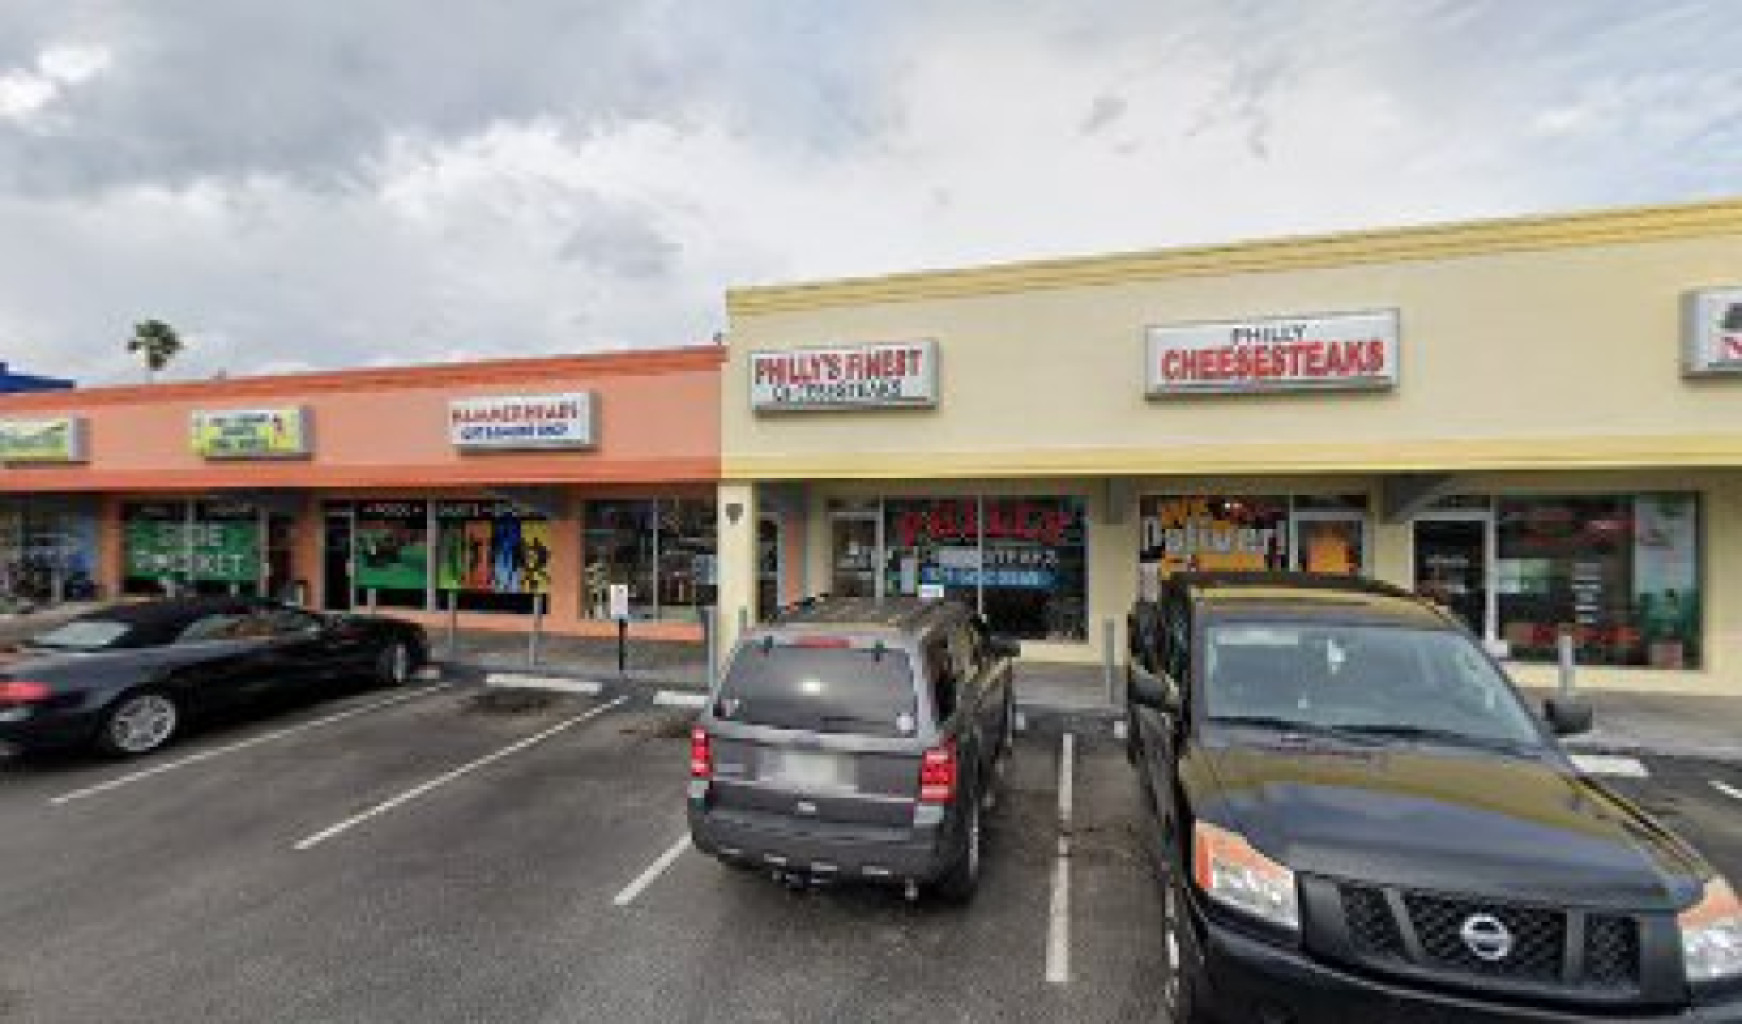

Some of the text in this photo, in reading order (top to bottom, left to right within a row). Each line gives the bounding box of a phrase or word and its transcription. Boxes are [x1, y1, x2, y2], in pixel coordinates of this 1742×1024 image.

[1230, 319, 1308, 344] PHILLY
[754, 349, 922, 386] PHILLY'S FINEST
[1161, 339, 1384, 380] CHEESESTEAKS
